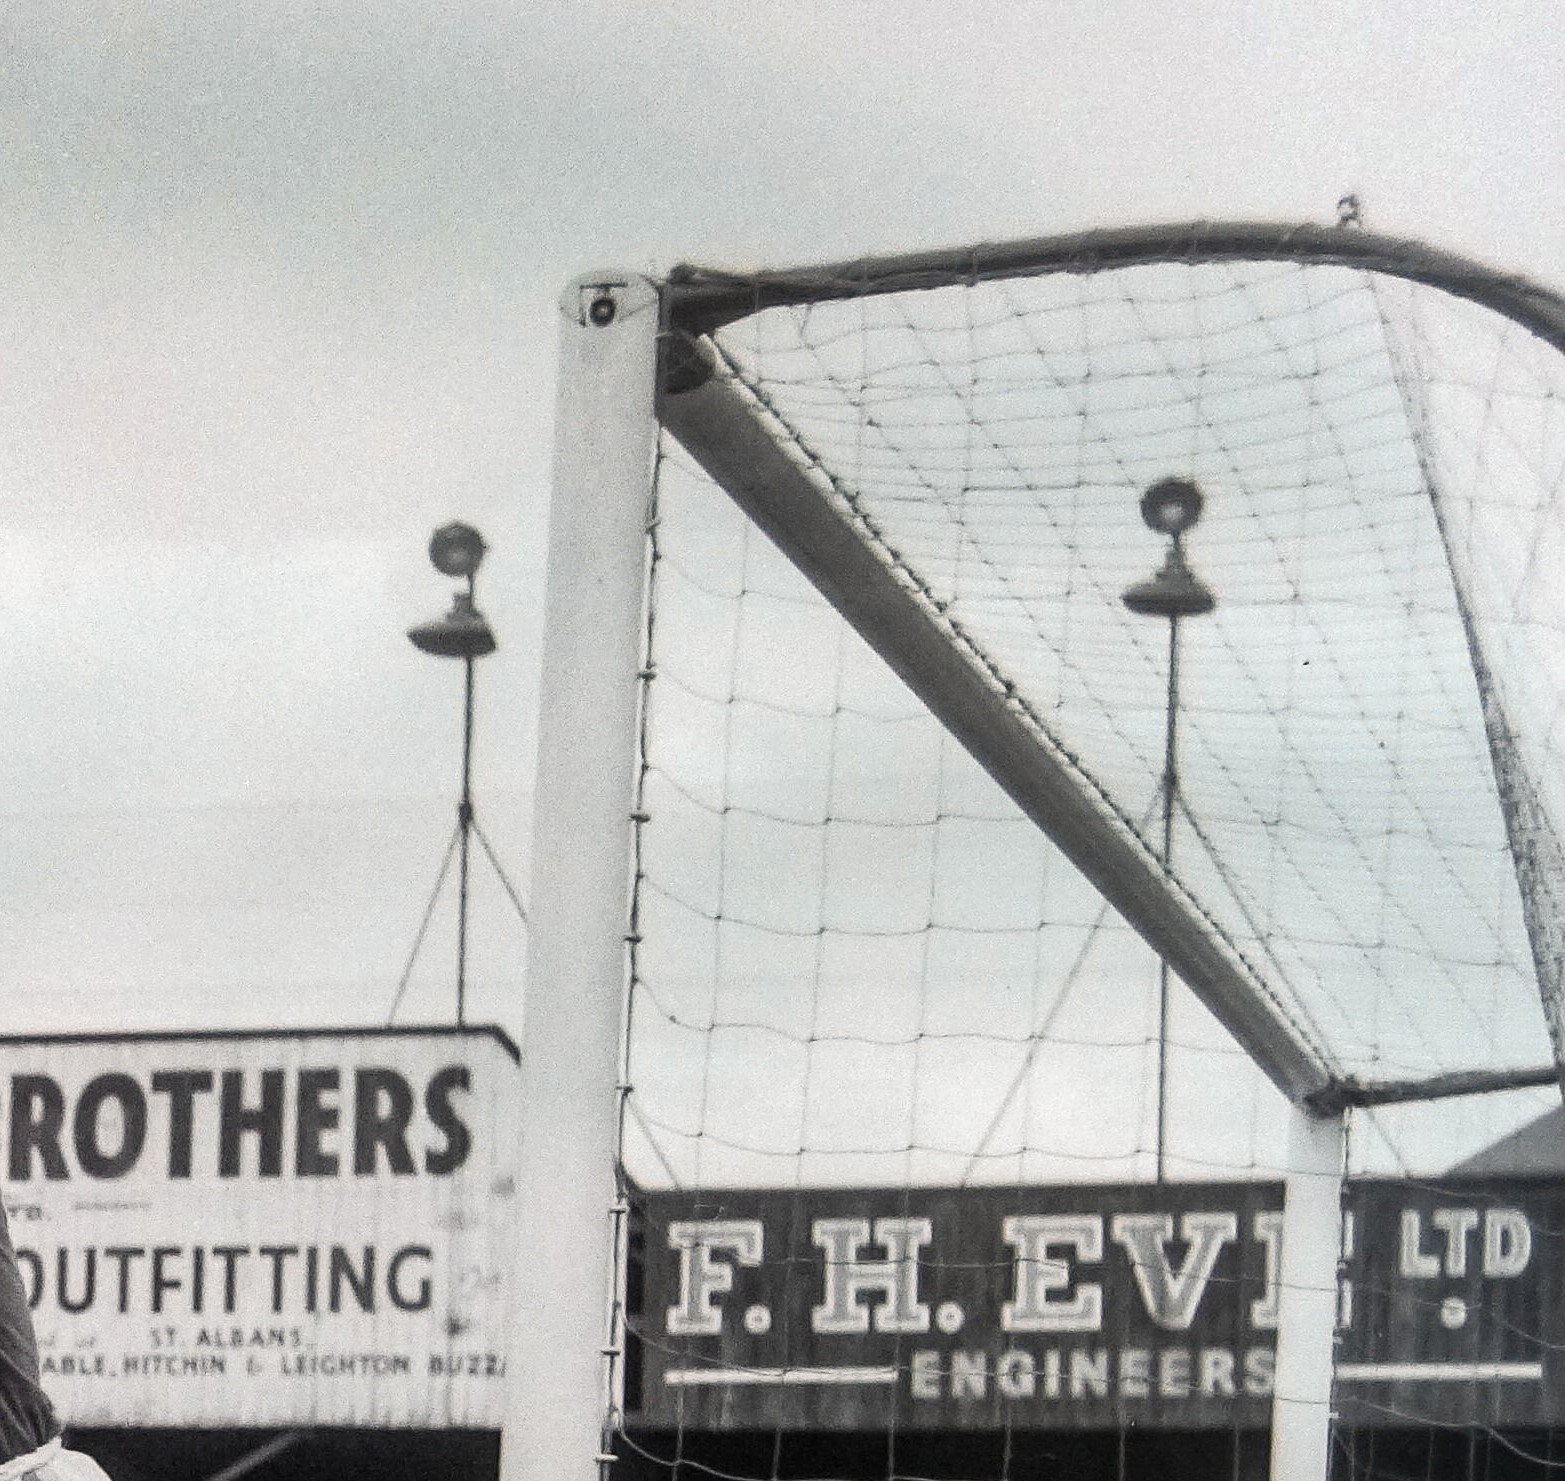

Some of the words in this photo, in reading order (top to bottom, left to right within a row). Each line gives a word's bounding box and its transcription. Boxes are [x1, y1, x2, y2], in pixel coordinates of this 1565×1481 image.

[666, 1218, 773, 1337] F.
[810, 1216, 967, 1336] H.
[122, 1353, 227, 1378] HITCHIN
[280, 1353, 411, 1378] LEIGHTON
[427, 1352, 507, 1379] BUZZ
[910, 1347, 1277, 1401] ENGINEERS
